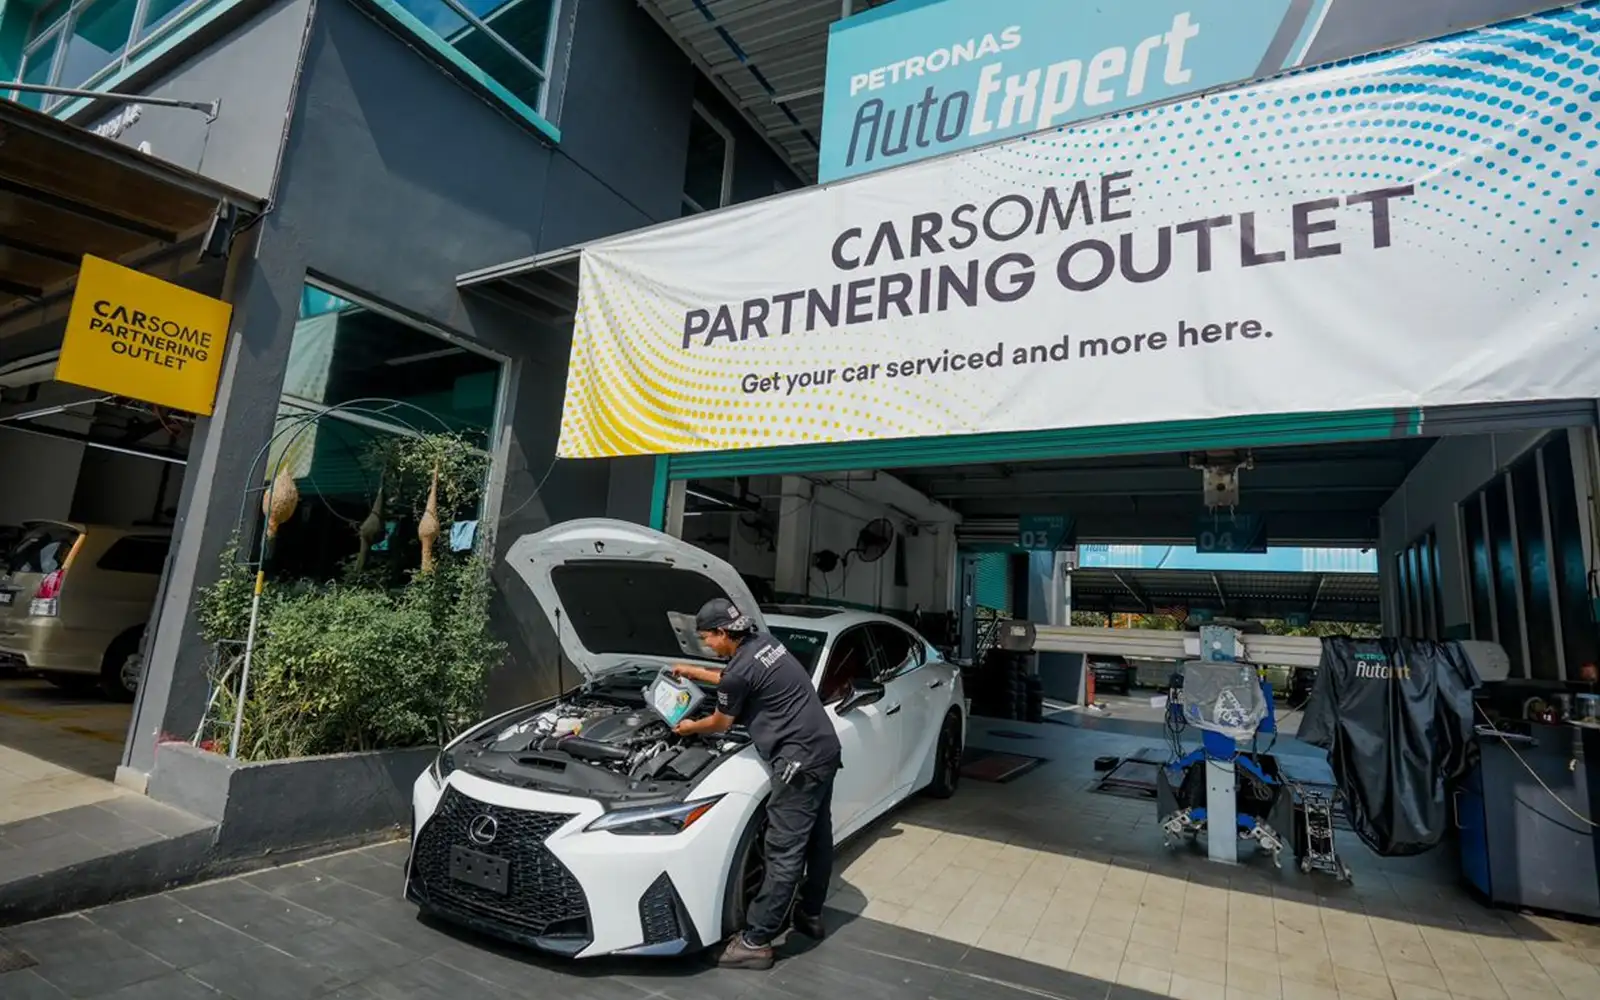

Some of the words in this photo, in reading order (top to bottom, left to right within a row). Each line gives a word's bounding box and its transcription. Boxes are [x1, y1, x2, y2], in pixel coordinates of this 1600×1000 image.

[845, 11, 1200, 168] AutoExpert
[849, 25, 1022, 97] PETRONAS
[831, 169, 1134, 271] CARSOME
[681, 252, 1036, 349] PARTNERING
[1056, 184, 1415, 292] OUTLET
[89, 318, 208, 362] PARTNERING
[93, 300, 212, 348] CARSOME
[111, 340, 187, 371] OUTLET
[741, 371, 780, 394] Get
[785, 366, 836, 397] your
[841, 359, 880, 384] car
[886, 342, 1003, 379] serviced
[1012, 335, 1069, 366] and
[1079, 331, 1167, 359] more
[1178, 319, 1274, 348] here.
[1021, 530, 1048, 548] 03
[1200, 531, 1234, 551] 04
